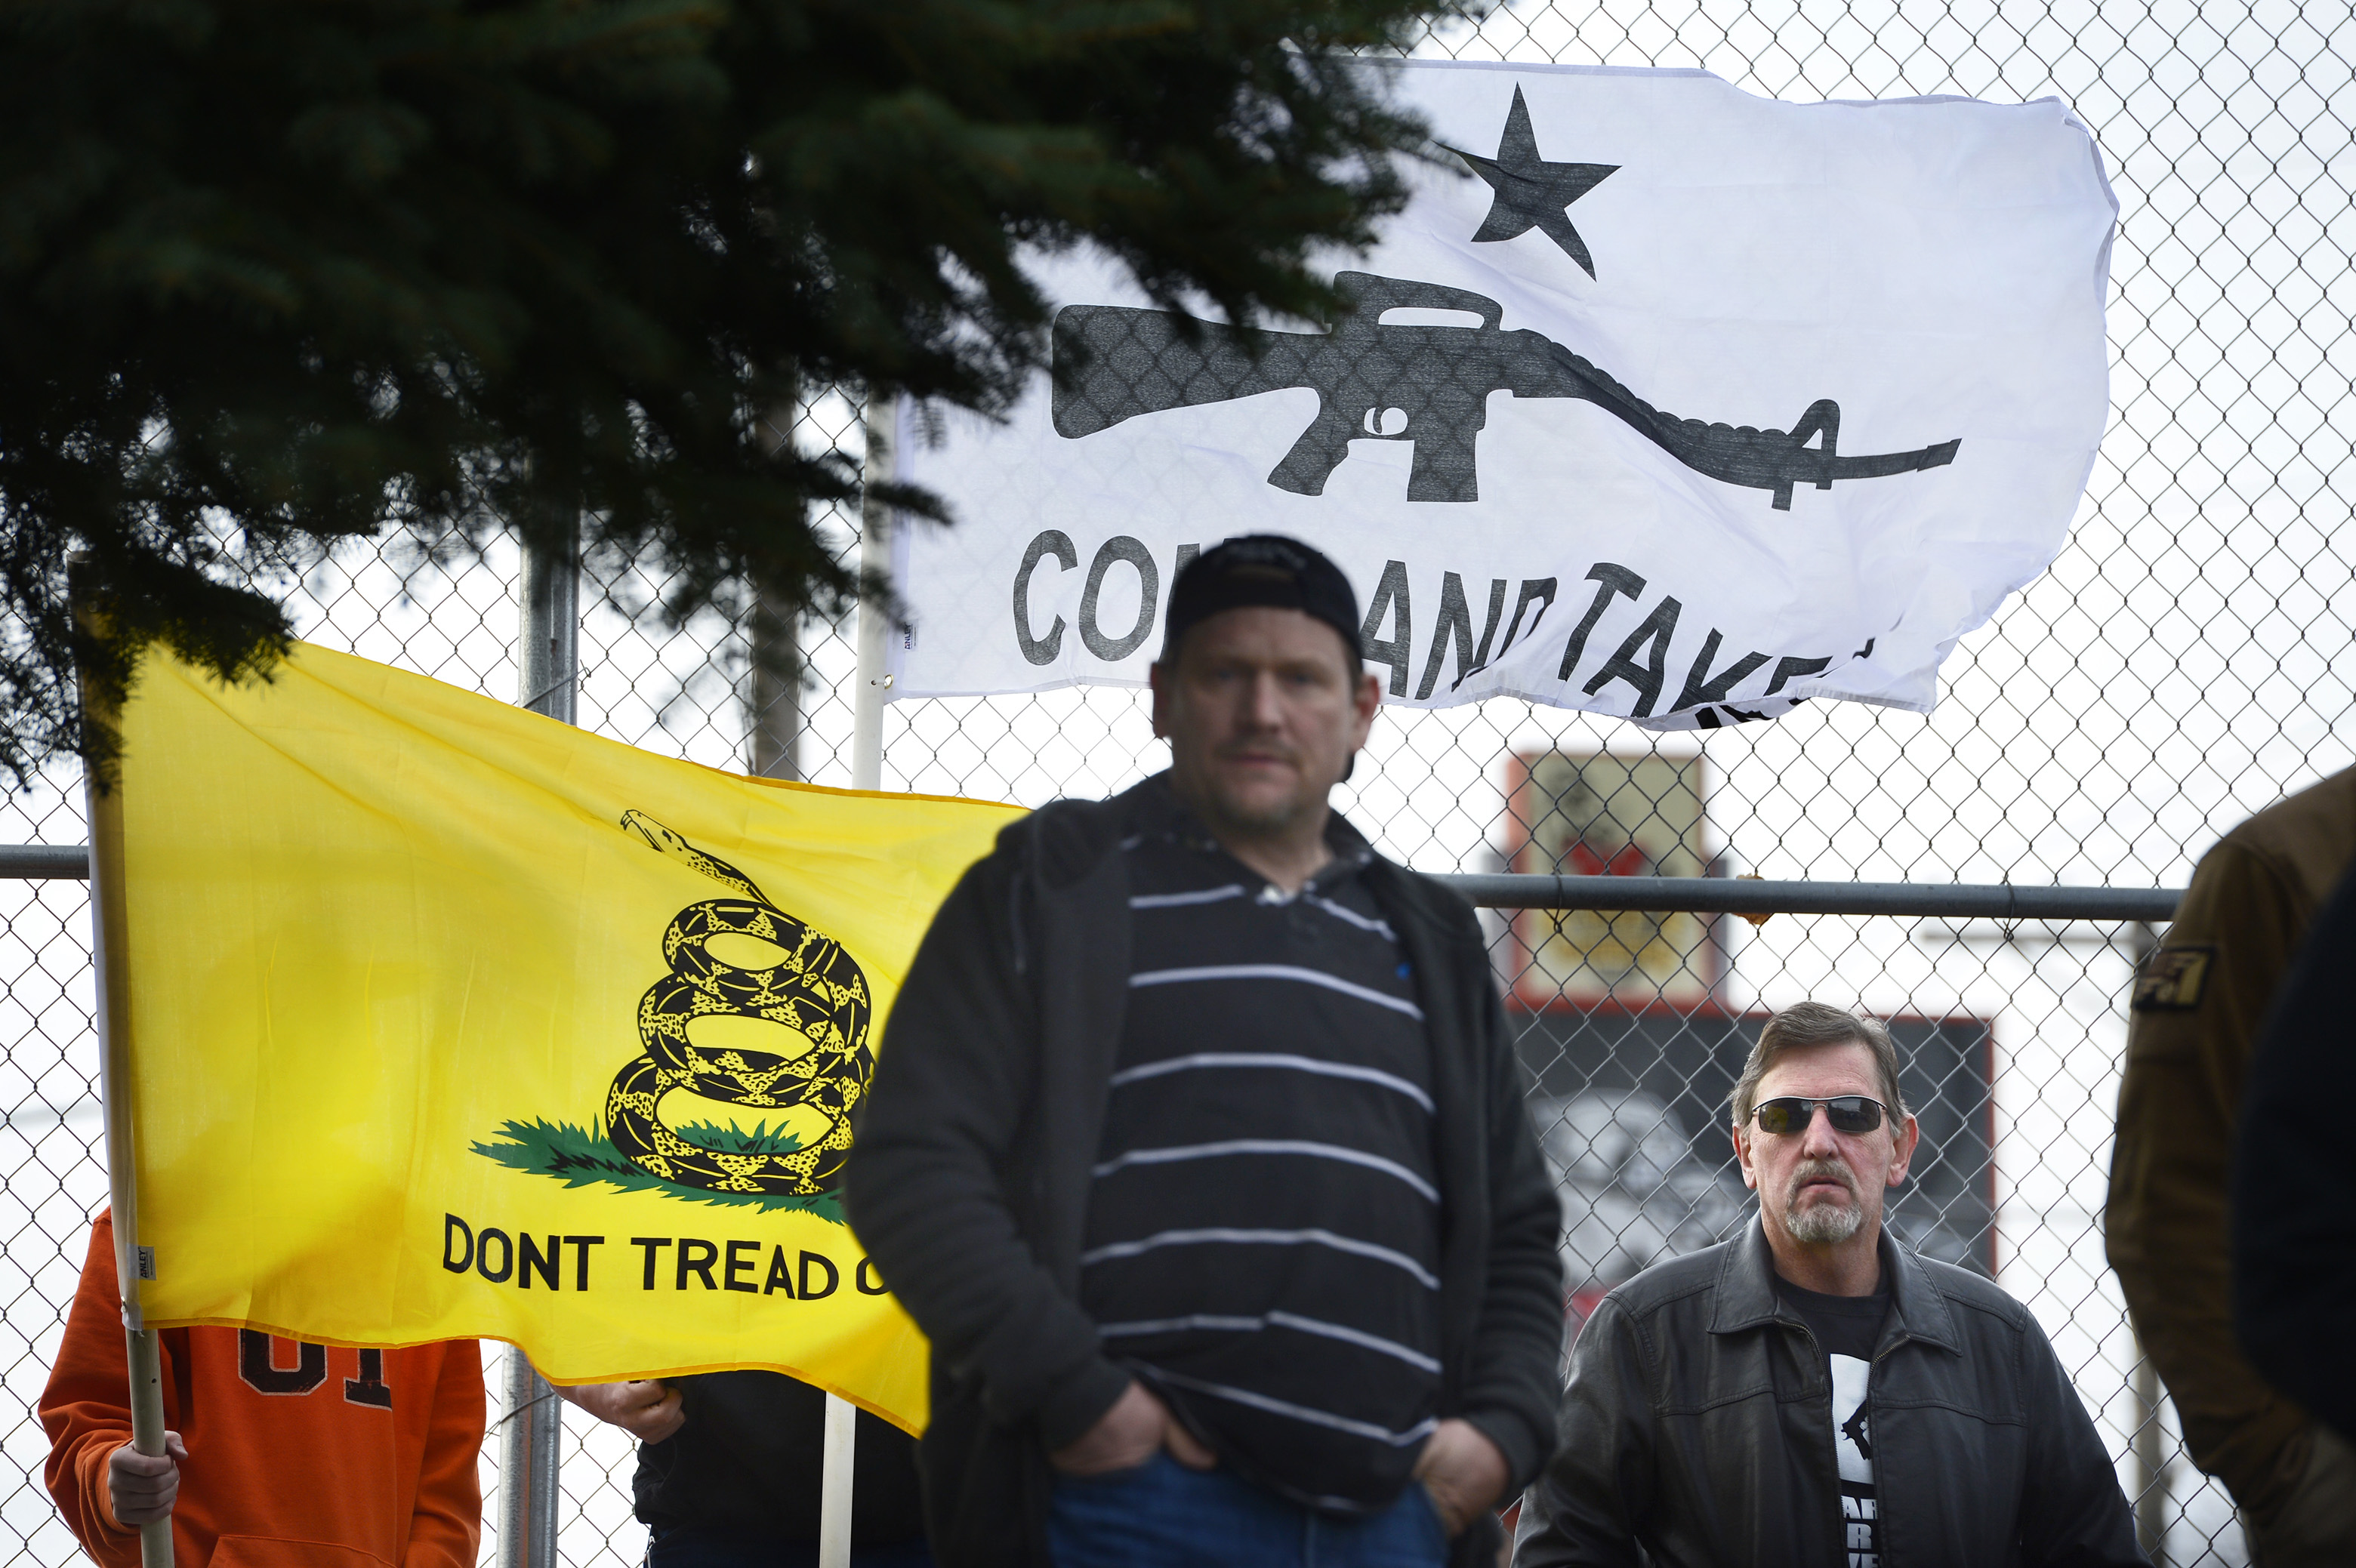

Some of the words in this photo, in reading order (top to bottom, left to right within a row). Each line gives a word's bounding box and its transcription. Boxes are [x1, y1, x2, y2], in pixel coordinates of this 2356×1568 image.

[1013, 529, 1201, 666] CO
[138, 1247, 147, 1278] ANLEY
[443, 1212, 605, 1291] DONT
[631, 1237, 840, 1300] TREAD
